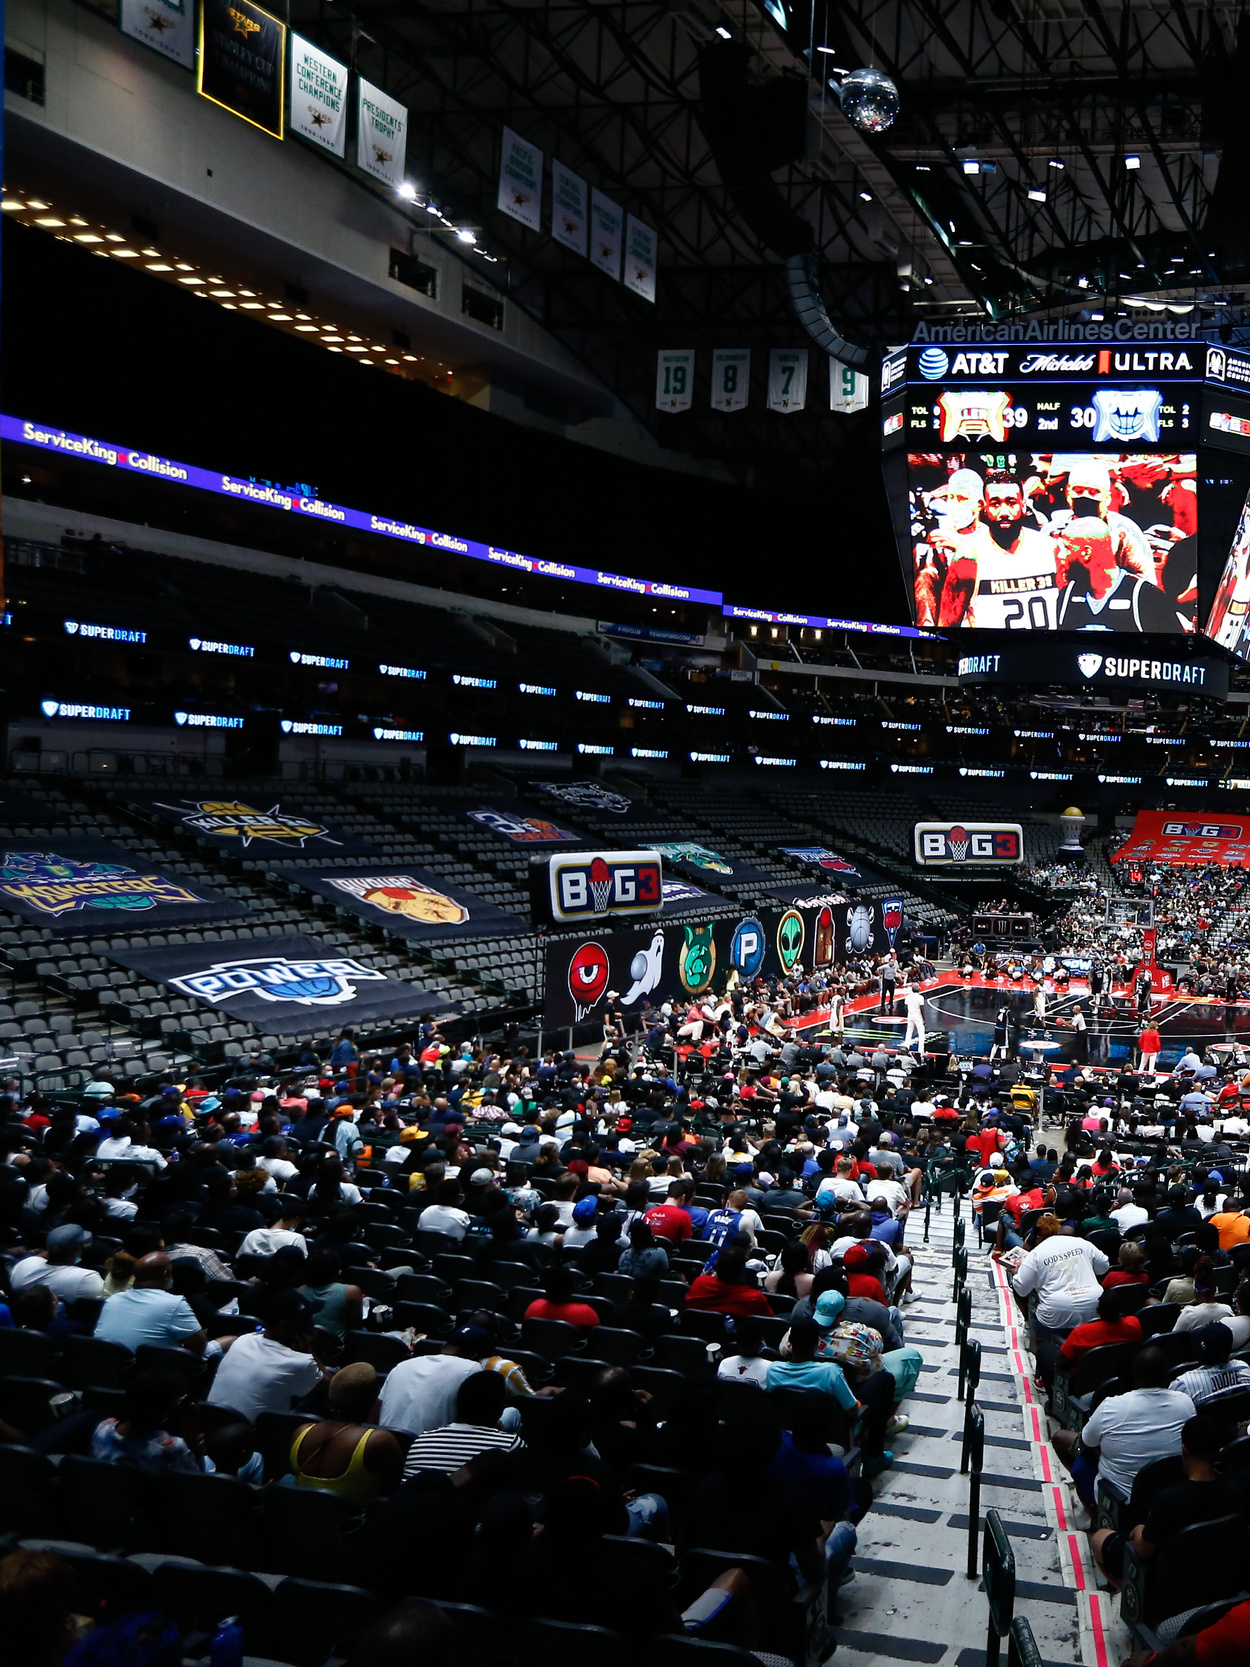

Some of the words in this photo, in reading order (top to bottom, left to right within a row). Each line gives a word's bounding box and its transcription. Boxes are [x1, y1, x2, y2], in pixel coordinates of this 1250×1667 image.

[227, 7, 261, 33] STARS
[304, 54, 338, 84] WESTERN
[296, 63, 343, 100] CONFERENCE
[298, 79, 341, 113] CHAMPIONS
[371, 116, 396, 141] TROPHY
[952, 353, 1009, 374] AT&T
[1019, 353, 1095, 374] Michelob
[1114, 352, 1191, 371] ULTRA
[664, 366, 687, 394] 19
[724, 365, 738, 394] 8
[781, 366, 804, 394] 7
[842, 367, 856, 396] 9
[911, 406, 929, 415] TOL
[1037, 402, 1061, 411] HALF
[1070, 406, 1097, 428] 30
[1159, 405, 1176, 415] TOL
[1182, 404, 1190, 415] 2
[910, 419, 927, 428] FLS
[932, 418, 941, 430] 2
[1002, 407, 1028, 429] 39
[1037, 417, 1059, 431] 2nd
[1158, 419, 1174, 428] FLS
[1182, 418, 1189, 429] 3
[23, 423, 117, 465] ServiceKing
[128, 452, 187, 479] Collision
[222, 476, 291, 510] ServiceKing
[300, 498, 344, 520] Collision
[371, 516, 425, 544] ServiceKing
[432, 533, 467, 552] Collision
[488, 547, 532, 571] ServiceKing
[538, 561, 575, 577] Collision
[598, 572, 645, 593] ServiceKing
[651, 584, 689, 598] Collision
[991, 577, 1038, 593] KILLER
[733, 607, 772, 621] ServiceKing
[777, 614, 807, 624] Collision
[1004, 598, 1050, 629] 20
[80, 625, 147, 643] SUPERDRAFT
[827, 619, 867, 632] ServiceKing
[872, 624, 900, 634] Collision
[200, 641, 254, 657] SUPERDRAFT
[300, 654, 349, 669] SUPERDRAFT
[387, 666, 426, 679] SUPERDRAFT
[1105, 659, 1206, 686] SUPERDRAFT
[59, 704, 130, 720] SUPERDRAFT
[187, 714, 244, 728] SUPERDRAFT
[292, 722, 343, 735] SUPERDRAFT
[383, 729, 423, 741] SUPERDRAFT
[459, 735, 496, 746] SUPERDRAFT
[828, 762, 866, 770] SUPERDRAFT
[967, 769, 1004, 777] SUPERDRAFT
[192, 814, 279, 828] KILLER
[3, 876, 198, 912] MONSTERS
[740, 931, 760, 968] P
[1042, 957, 1056, 972] VS
[188, 962, 357, 995] POWER
[1043, 1255, 1063, 1266] GOD'S
[1063, 1248, 1083, 1259] SPEED
[1211, 1370, 1240, 1392] JUDGE
